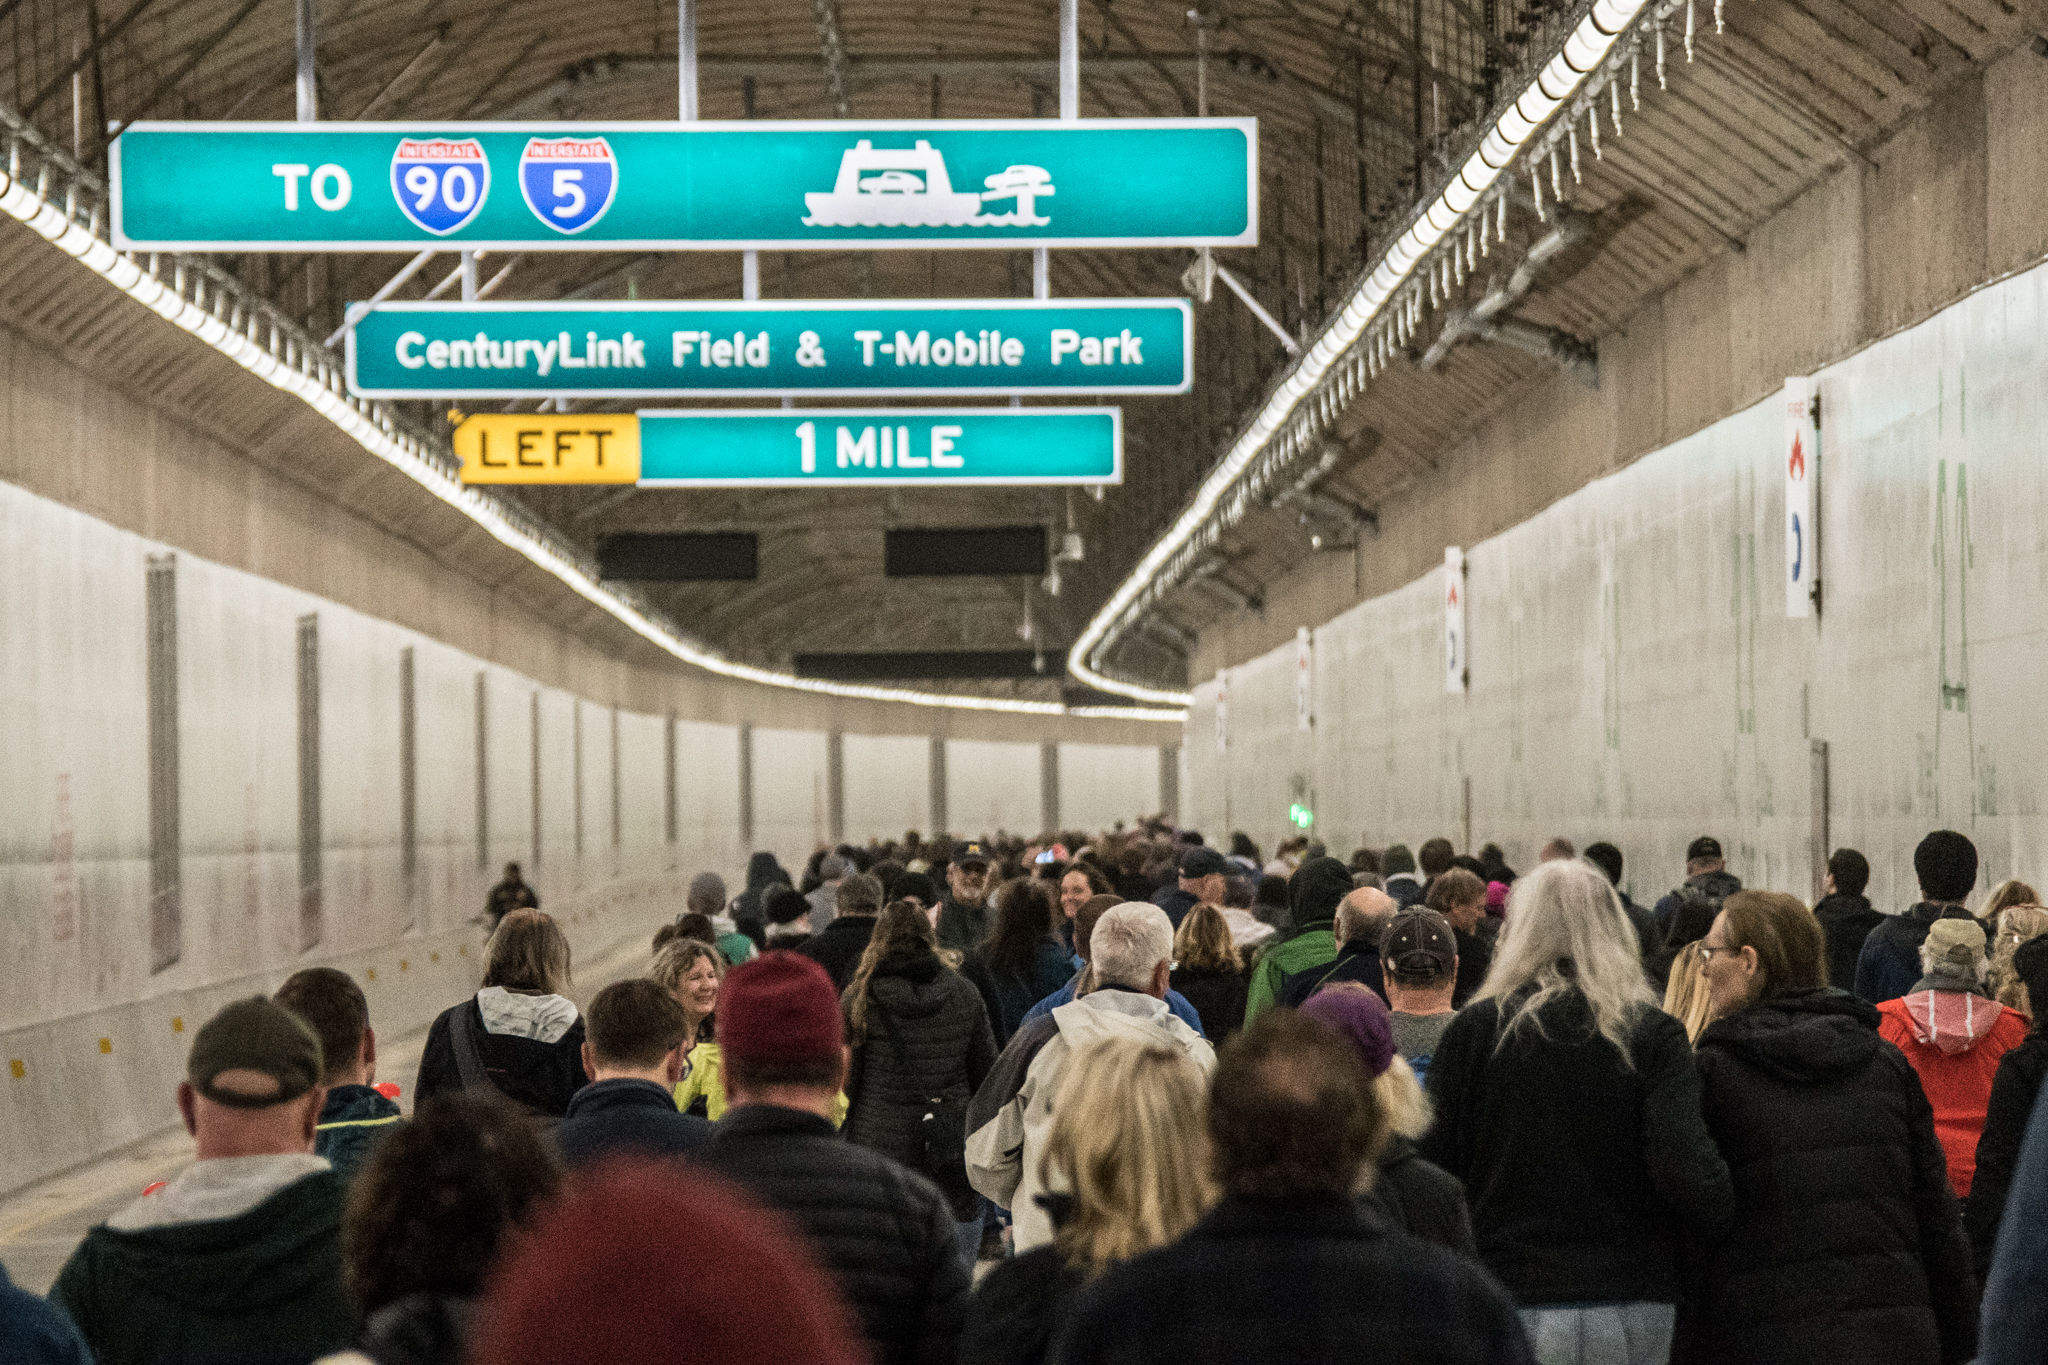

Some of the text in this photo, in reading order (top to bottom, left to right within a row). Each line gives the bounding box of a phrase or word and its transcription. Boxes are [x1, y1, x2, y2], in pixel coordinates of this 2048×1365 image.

[401, 143, 477, 158] INTERSTATE
[530, 143, 604, 157] INTERSTATE
[272, 163, 353, 212] TO
[404, 165, 477, 213] 90
[552, 169, 586, 218] 5
[395, 328, 1143, 376] CenturyLink Field & T-Mobile Park
[480, 430, 615, 467] LEFT
[796, 422, 964, 473] 1 MILE
